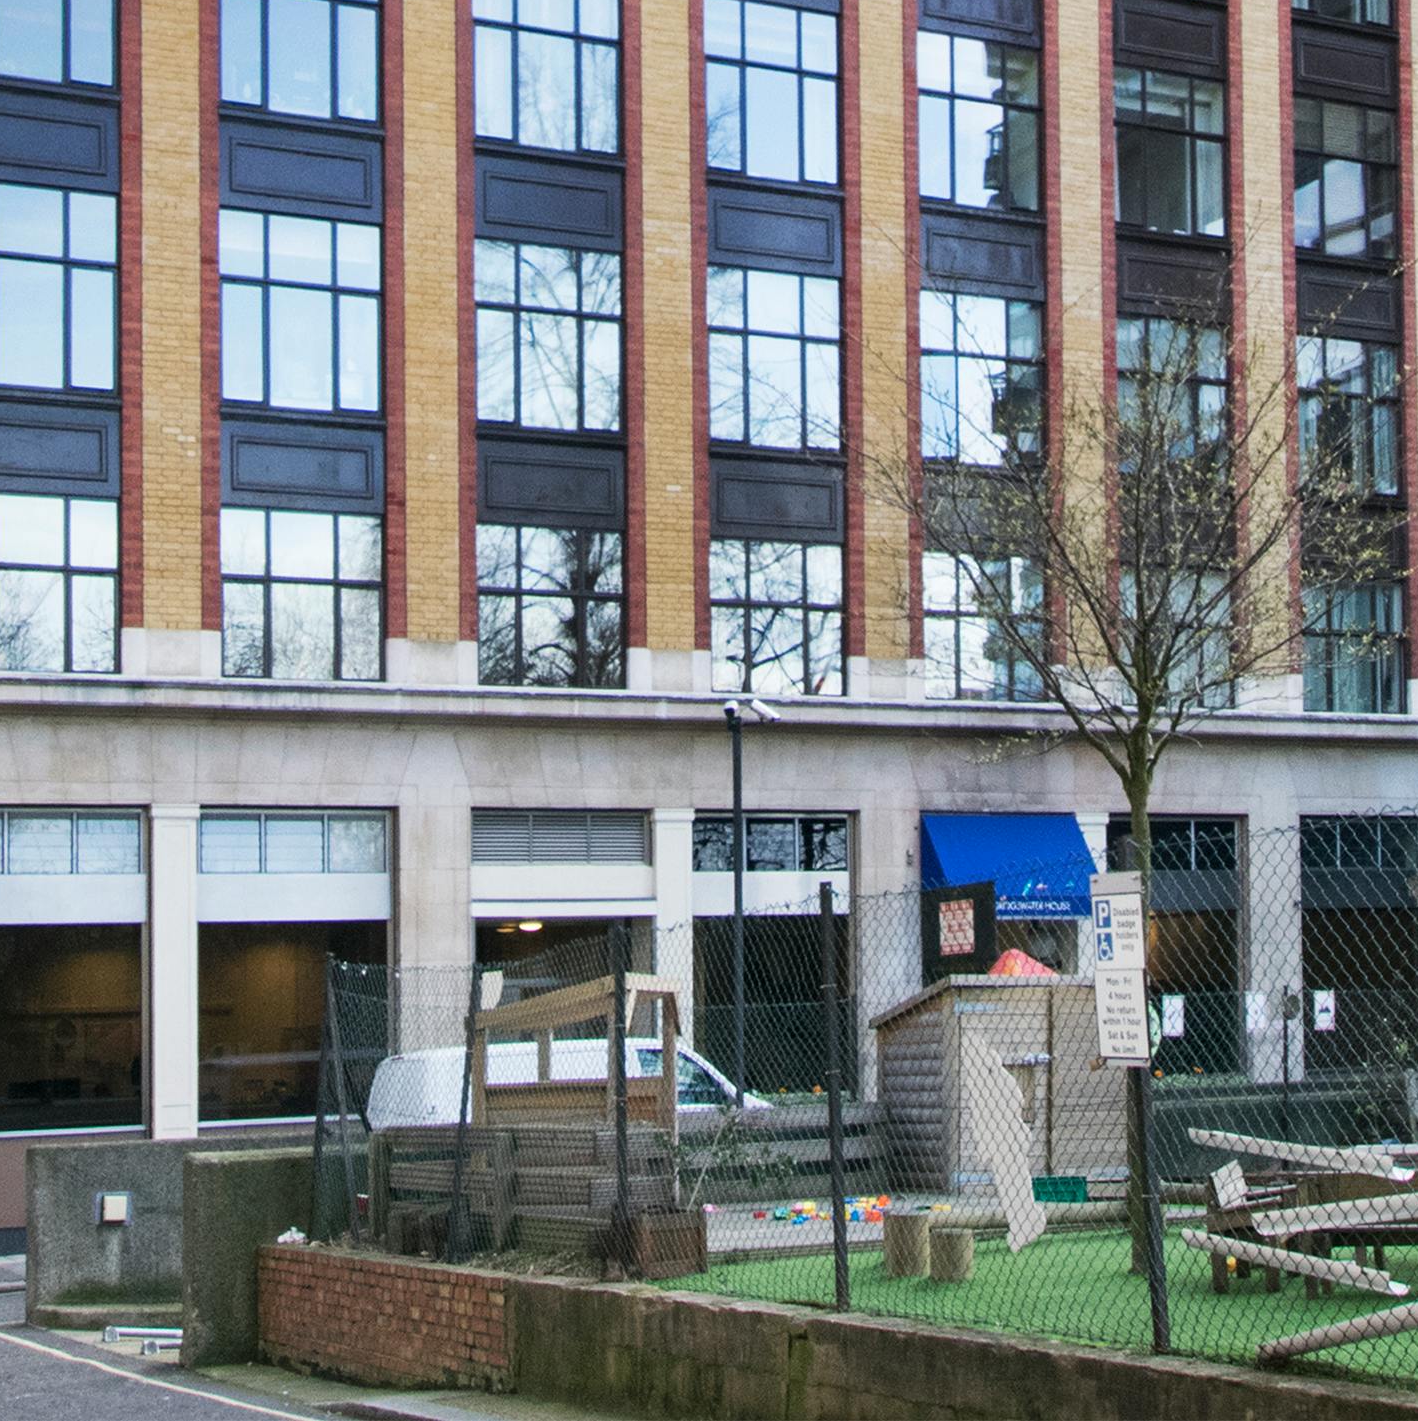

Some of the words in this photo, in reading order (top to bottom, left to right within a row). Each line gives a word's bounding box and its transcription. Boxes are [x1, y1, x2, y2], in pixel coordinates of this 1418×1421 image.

[1044, 900, 1071, 911] HOUSE
[1112, 907, 1140, 917] Disabled
[1116, 920, 1136, 930] badge
[1115, 931, 1139, 940] holders
[1121, 943, 1134, 952] only
[1106, 977, 1120, 986] Mon
[1108, 991, 1113, 1000] 4
[1114, 991, 1132, 1000] hours
[1106, 1005, 1115, 1014] No
[1116, 1005, 1136, 1014] return
[1102, 1017, 1121, 1025] within
[1127, 1017, 1142, 1026] hour
[1108, 1030, 1119, 1040] Sat
[1126, 1030, 1139, 1040] Sun
[1112, 1045, 1121, 1054] No
[1122, 1045, 1137, 1054] limit
